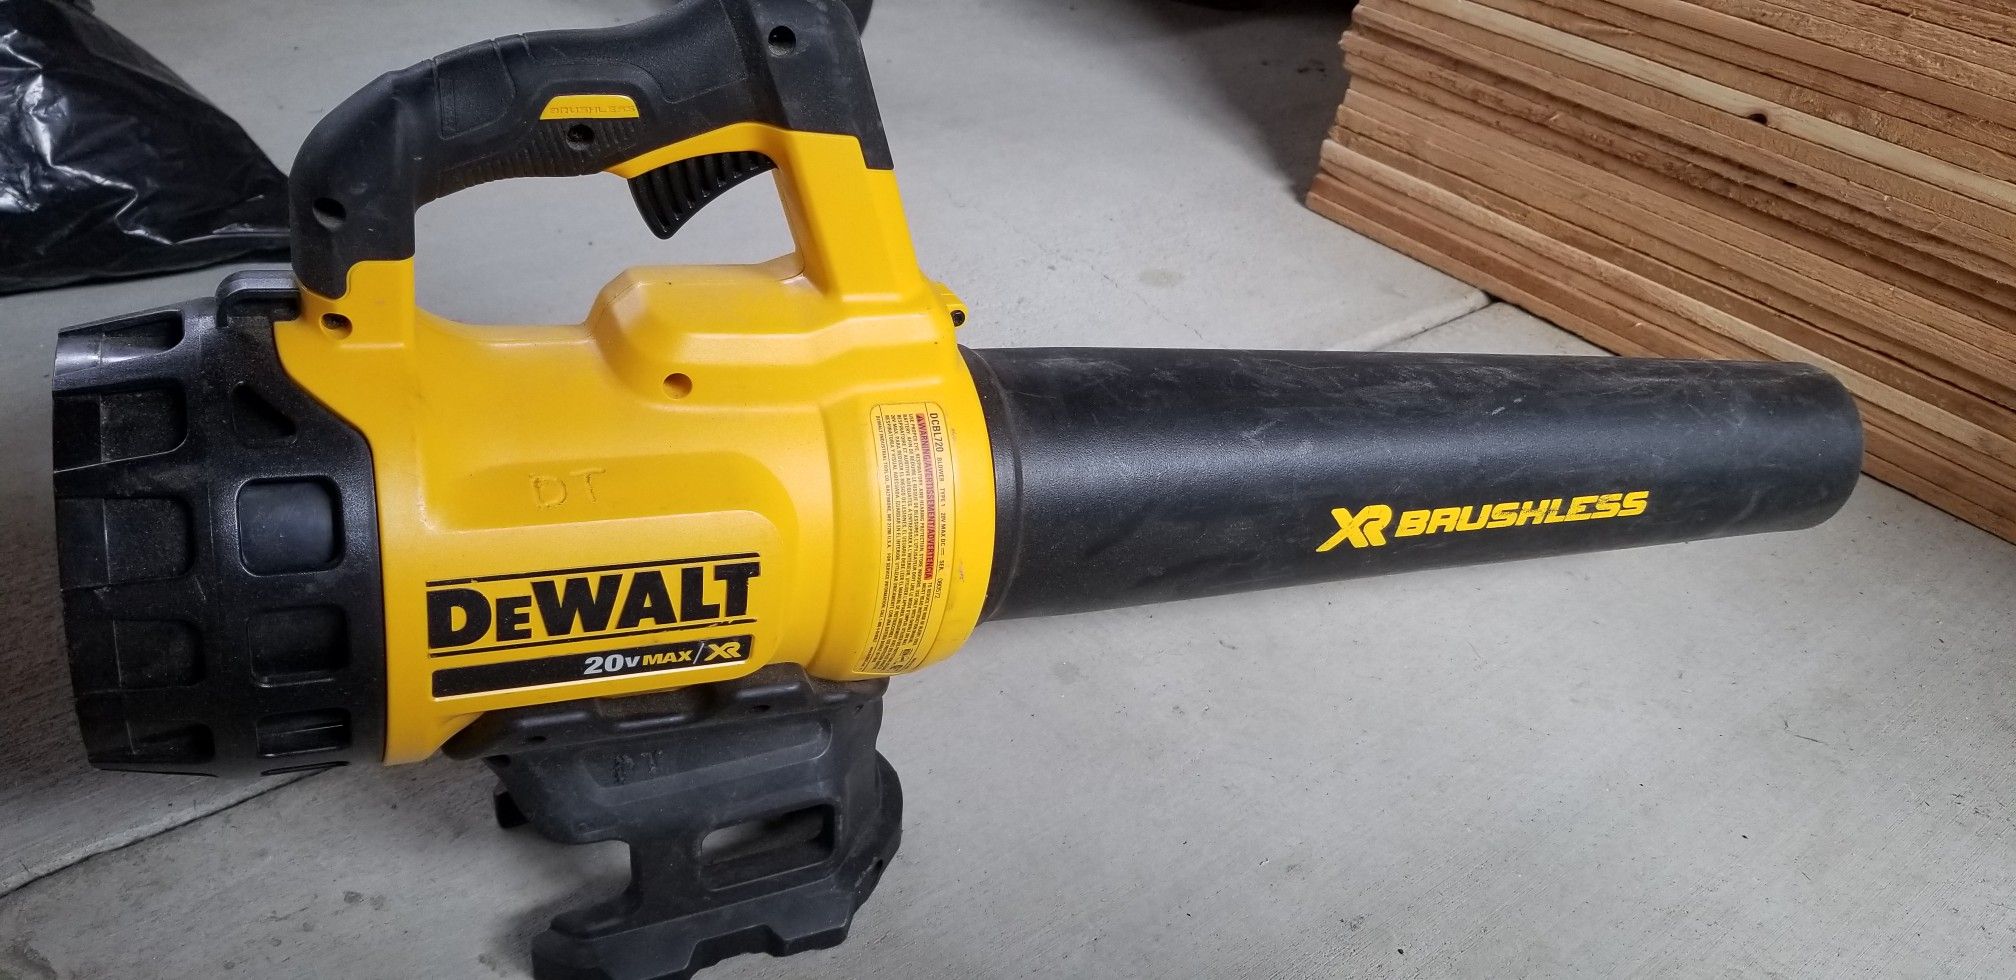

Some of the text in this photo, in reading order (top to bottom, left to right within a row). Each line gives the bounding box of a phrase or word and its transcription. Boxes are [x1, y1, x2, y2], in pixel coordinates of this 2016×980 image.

[929, 413, 945, 452] DCBL720
[528, 468, 607, 509] DT
[937, 458, 945, 482] BLOWER
[1315, 490, 1650, 553] XR BRUSHLESS
[940, 538, 945, 546] DC
